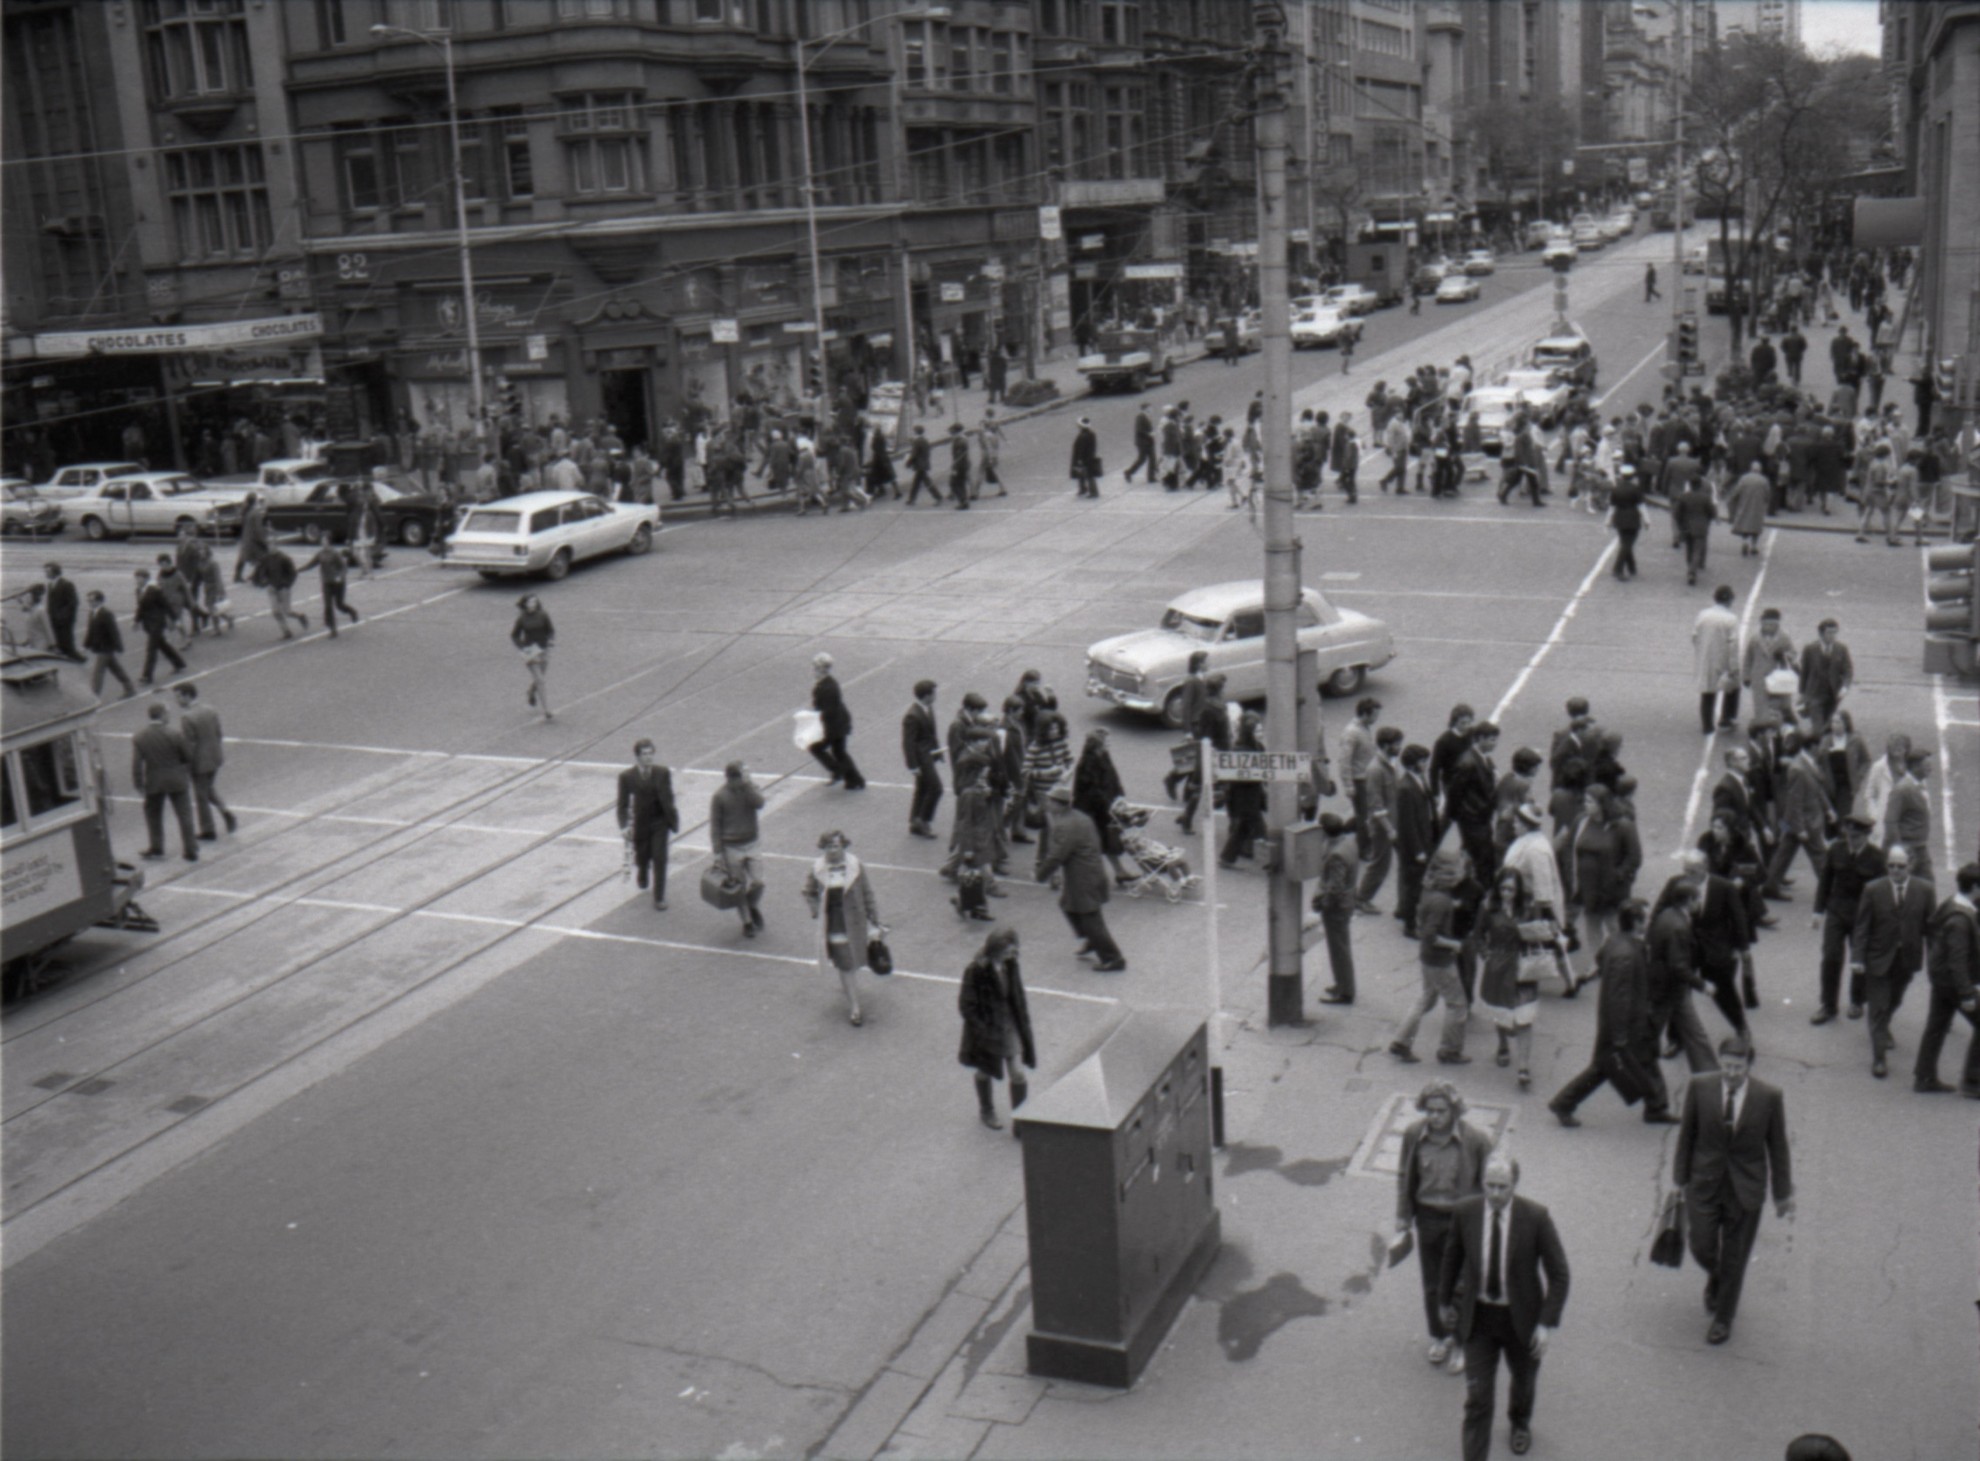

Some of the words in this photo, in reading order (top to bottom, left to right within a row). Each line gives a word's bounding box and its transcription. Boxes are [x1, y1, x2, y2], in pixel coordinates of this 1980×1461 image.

[338, 254, 368, 279] 82
[88, 333, 186, 350] CHOCOLATES
[251, 320, 317, 337] CHOCOLATES
[1219, 753, 1297, 770] ELIZABETH
